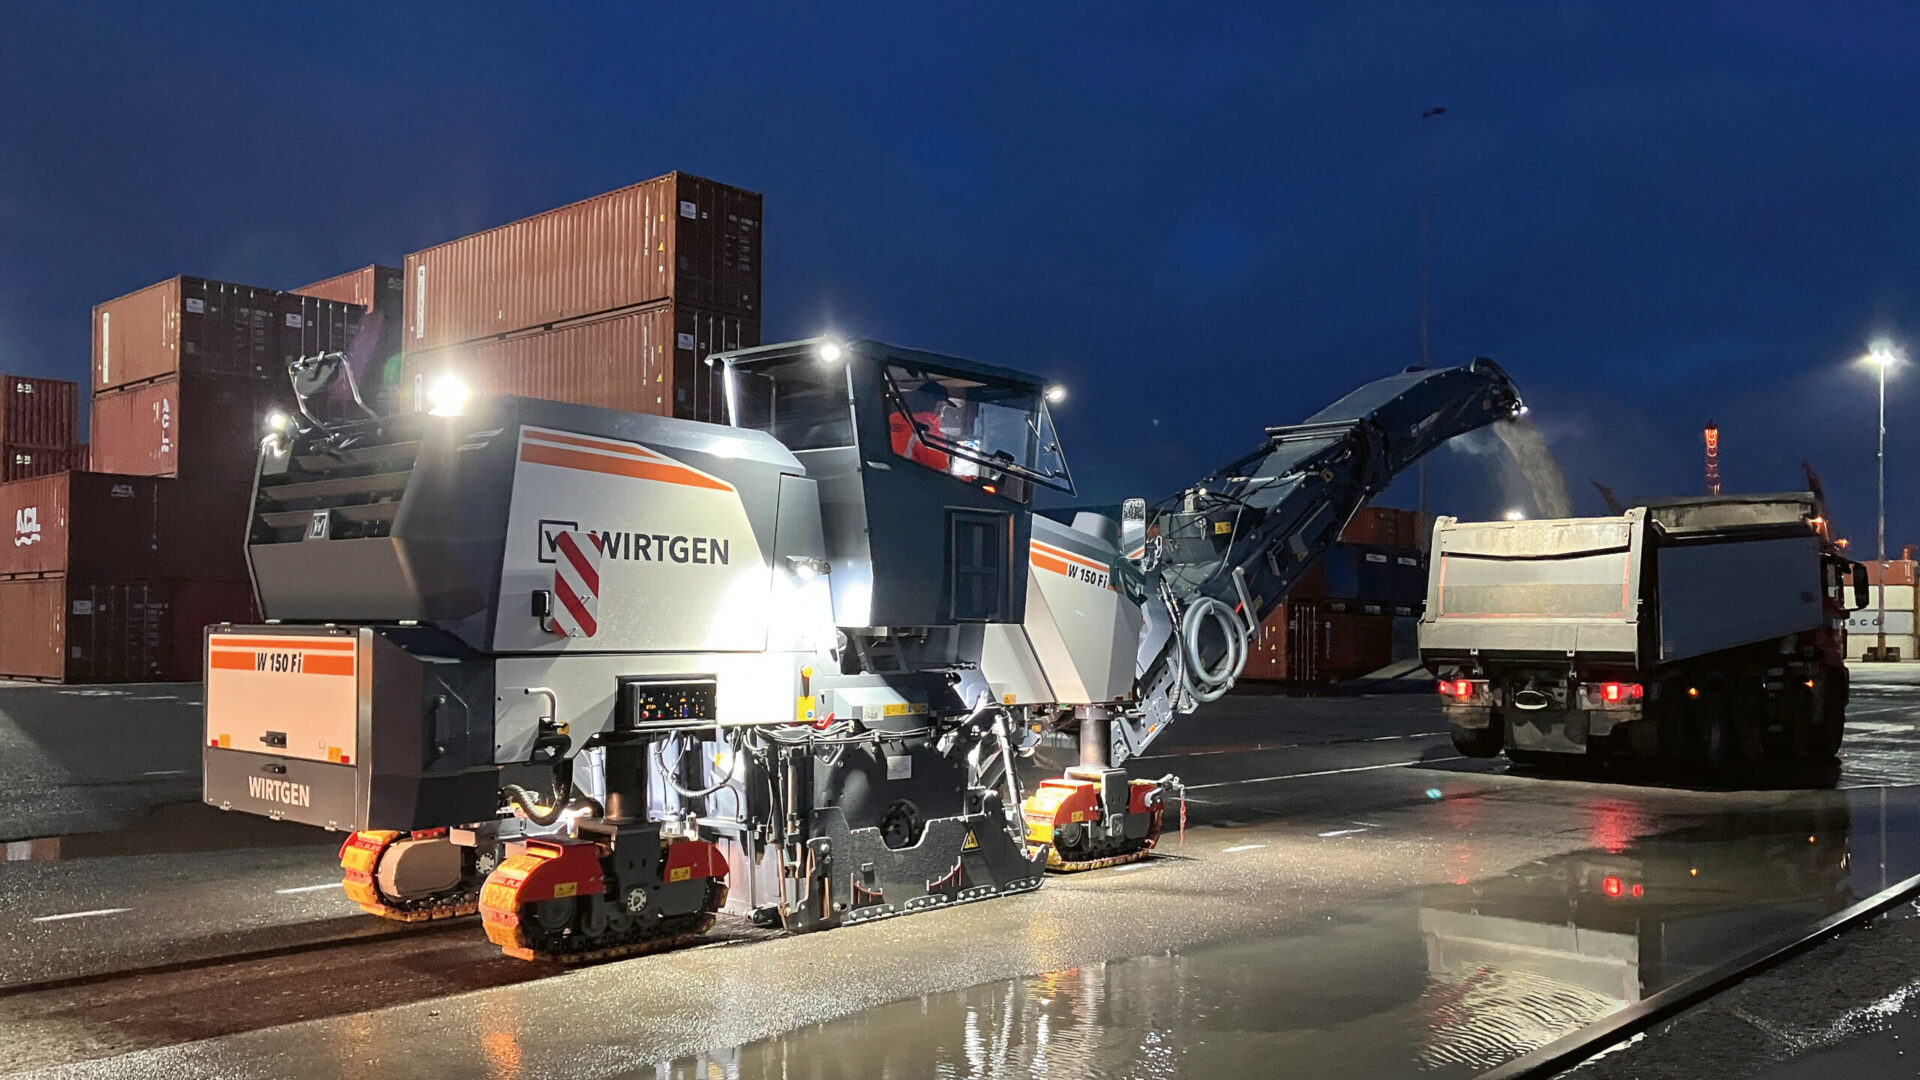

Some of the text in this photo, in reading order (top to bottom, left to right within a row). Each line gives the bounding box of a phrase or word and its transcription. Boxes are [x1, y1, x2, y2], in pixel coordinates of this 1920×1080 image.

[16, 507, 40, 533] ACL
[590, 530, 729, 565] WIRTGEN
[1068, 564, 1107, 589] W 150 Fi
[257, 651, 301, 673] W 150 Fi
[248, 775, 310, 808] WIRTGEN
